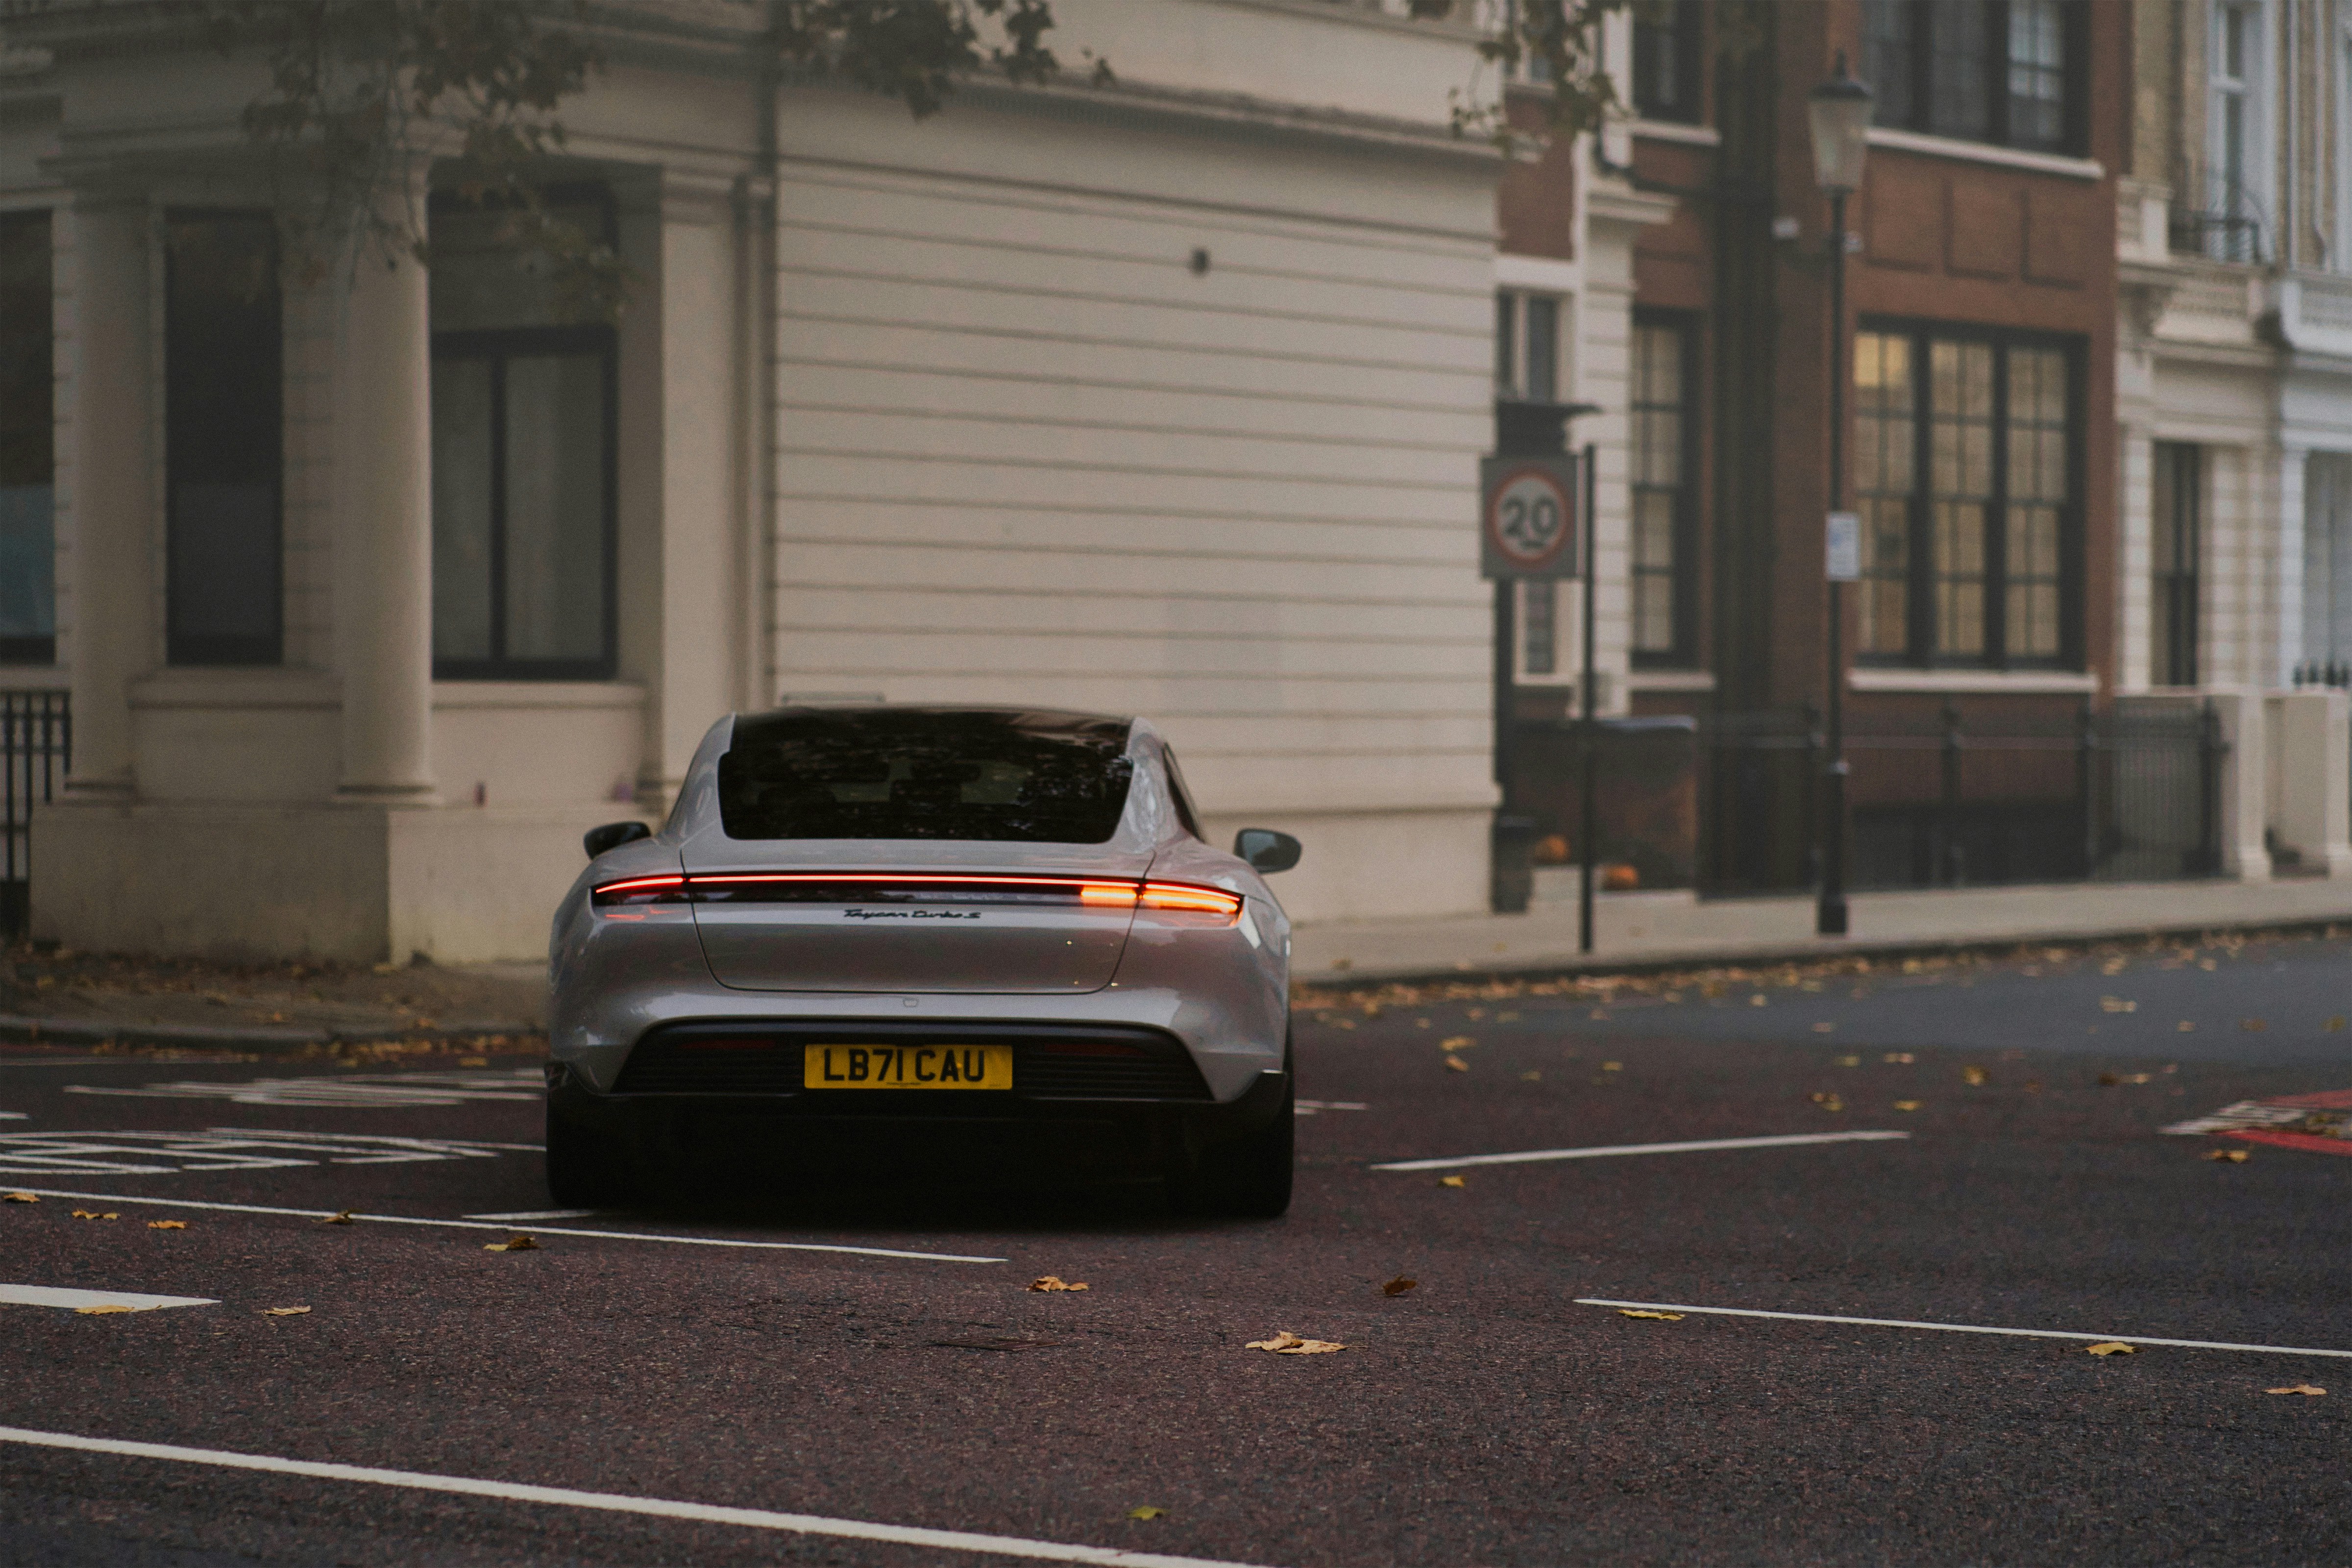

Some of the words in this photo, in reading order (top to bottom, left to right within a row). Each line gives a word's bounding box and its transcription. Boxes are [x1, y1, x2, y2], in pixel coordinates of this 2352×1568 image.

[1501, 494, 1559, 537] 20
[824, 1049, 904, 1081] LB71
[915, 1049, 984, 1082] CAU
